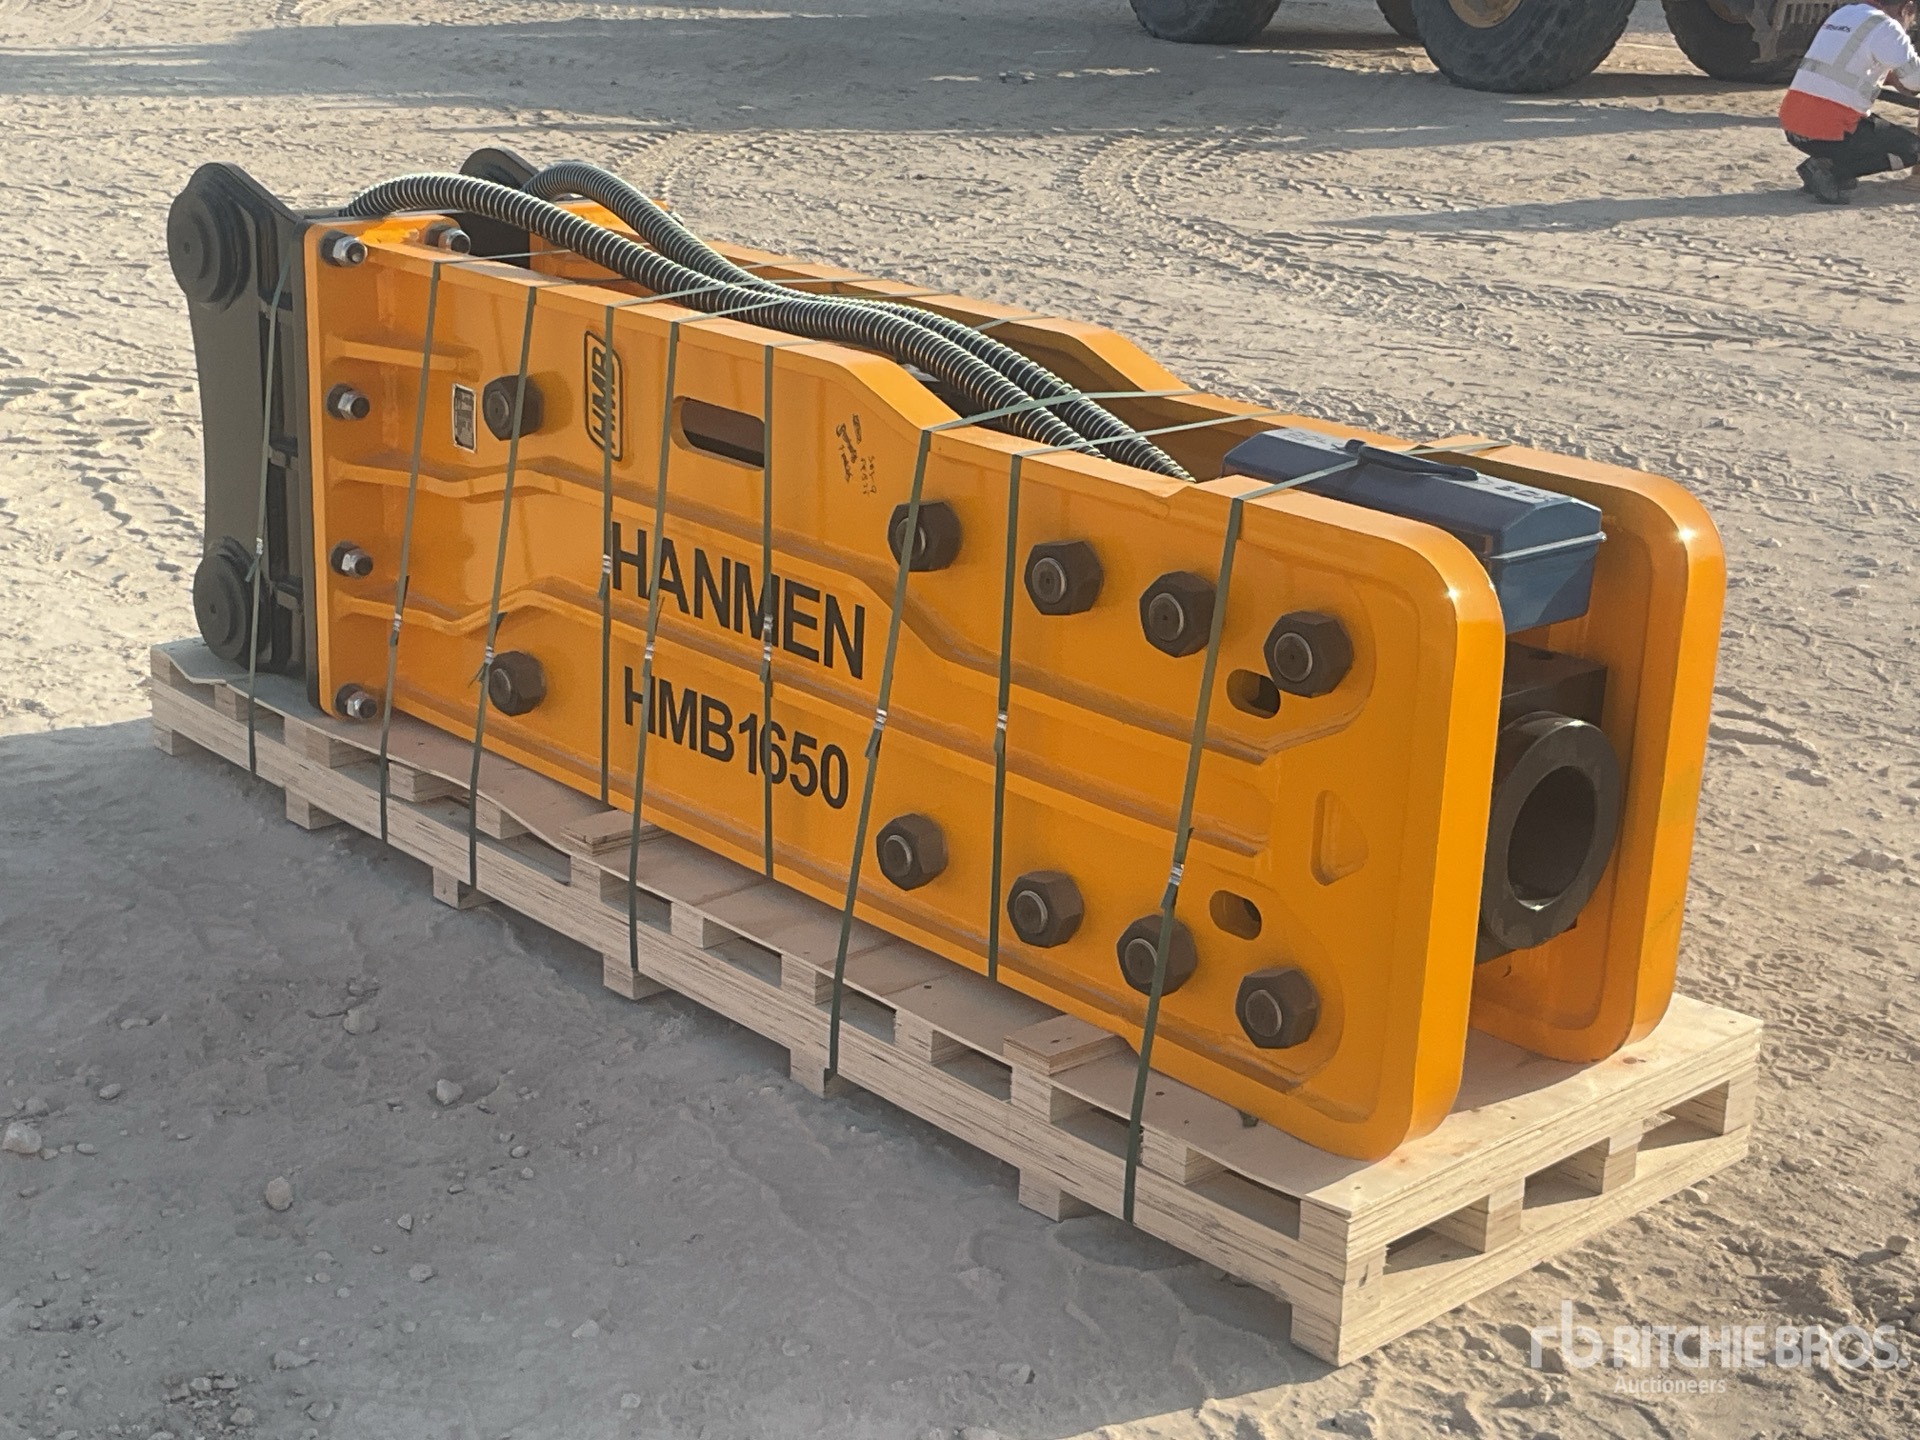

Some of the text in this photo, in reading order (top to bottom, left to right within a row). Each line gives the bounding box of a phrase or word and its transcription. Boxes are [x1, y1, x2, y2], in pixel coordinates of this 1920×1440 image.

[591, 346, 616, 450] HMB
[611, 521, 865, 680] HANMEN
[624, 665, 848, 809] HMB1650
